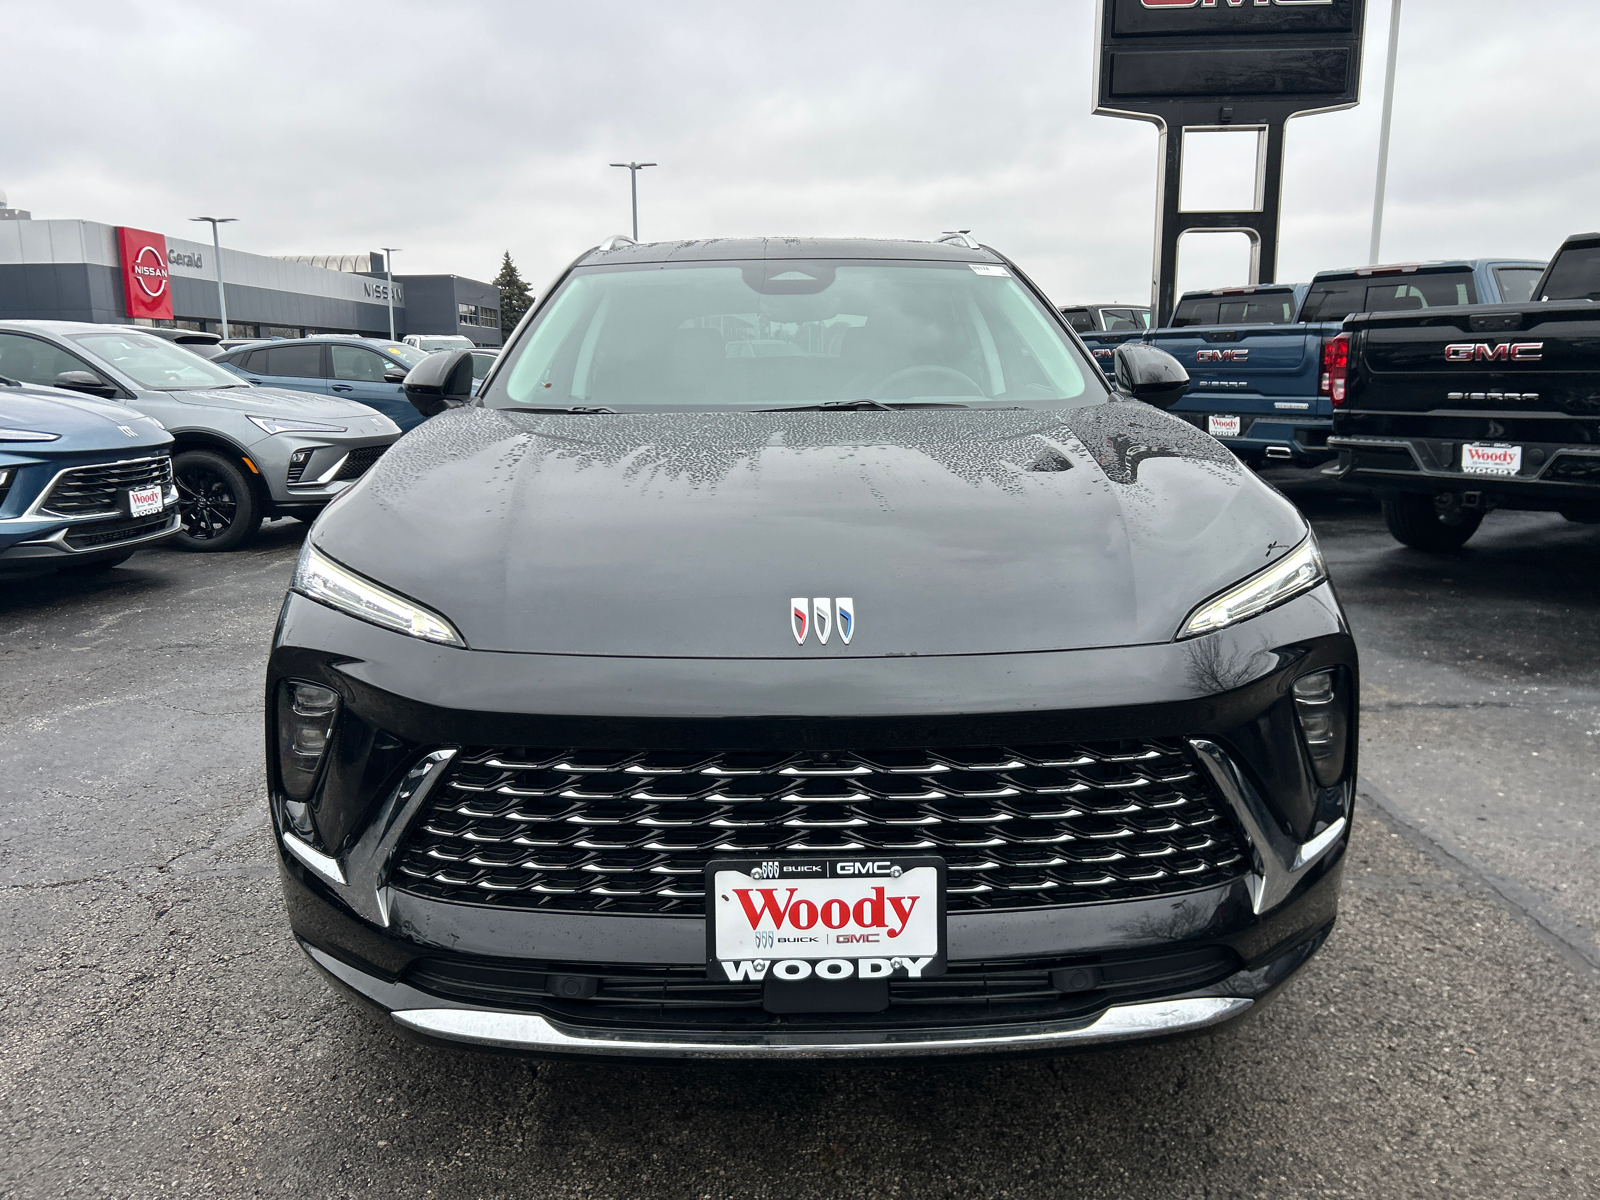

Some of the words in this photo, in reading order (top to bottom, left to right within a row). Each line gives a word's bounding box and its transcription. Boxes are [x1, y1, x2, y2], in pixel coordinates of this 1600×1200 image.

[168, 249, 203, 269] Gerald
[134, 265, 168, 278] NISSAN
[1093, 348, 1116, 358] GM
[1196, 349, 1249, 362] GMC
[1444, 342, 1543, 362] GMC
[1447, 392, 1540, 400] SIERRA
[1211, 418, 1237, 430] Woody
[1468, 448, 1516, 465] Woody
[1463, 467, 1518, 476] WOODY
[131, 491, 159, 503] Woody
[133, 507, 163, 517] WOODY
[837, 862, 891, 874] GMC
[732, 886, 920, 939] Woody
[836, 933, 880, 944] GMC
[721, 958, 933, 981] WOODY
